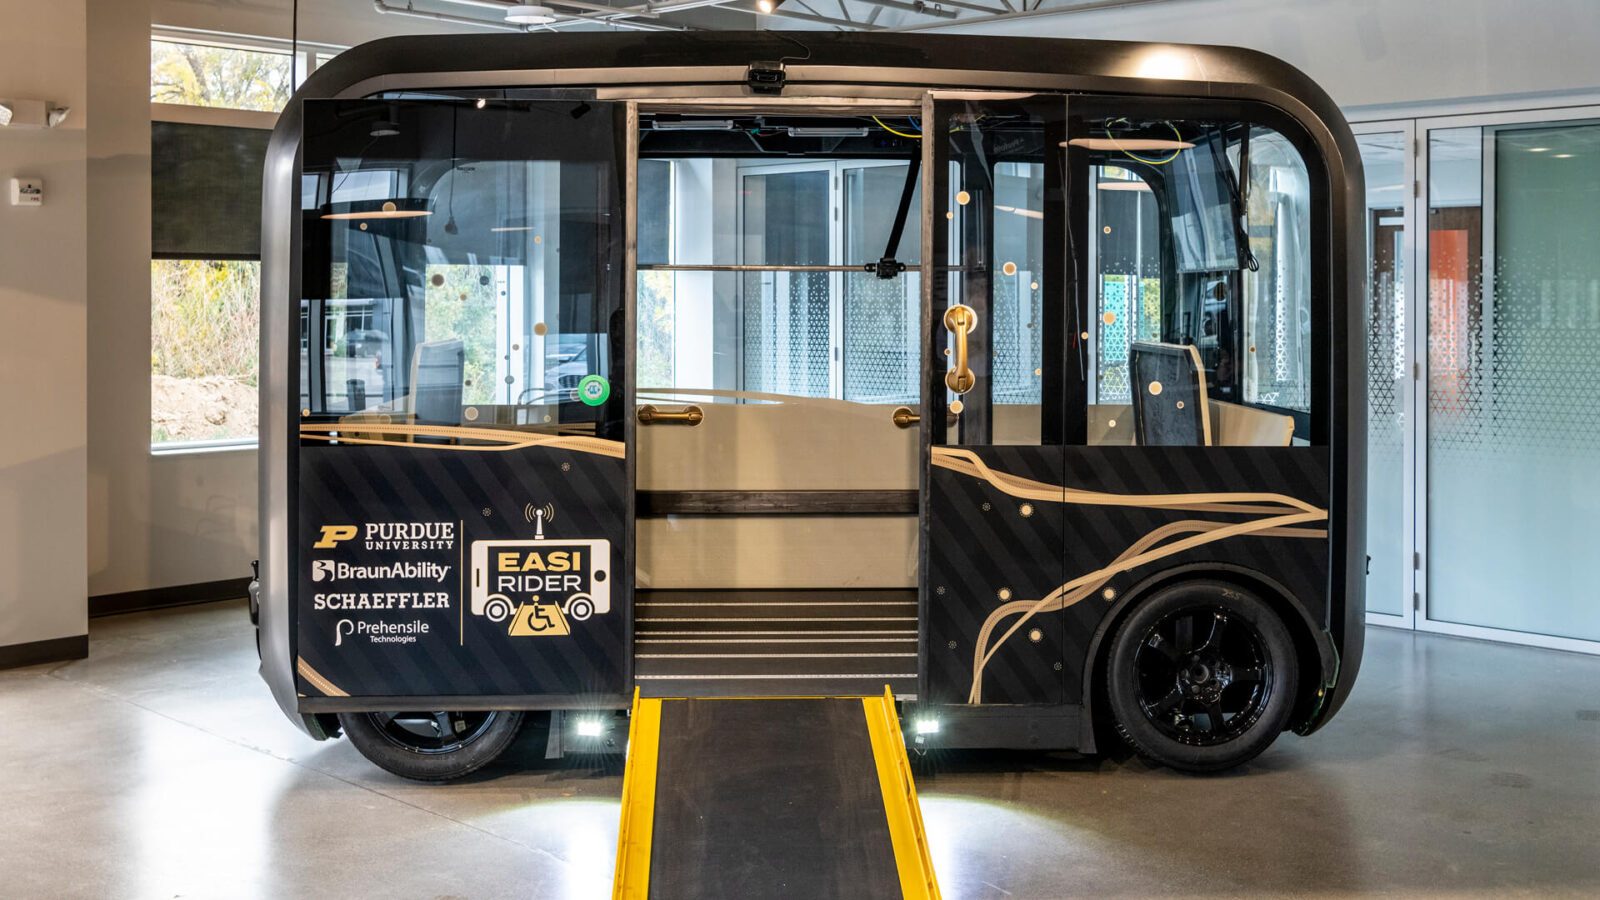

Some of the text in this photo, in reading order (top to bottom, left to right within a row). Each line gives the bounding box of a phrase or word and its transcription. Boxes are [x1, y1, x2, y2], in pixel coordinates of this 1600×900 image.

[313, 522, 455, 549] P PURDUE
[365, 540, 454, 550] UNIVERSITY
[498, 551, 581, 572] EASI
[337, 561, 450, 583] BraunAbility
[498, 575, 582, 592] RIDER
[313, 592, 450, 610] SCHAEFFLER
[357, 620, 430, 634] Prehensile
[370, 635, 417, 644] Technologies
